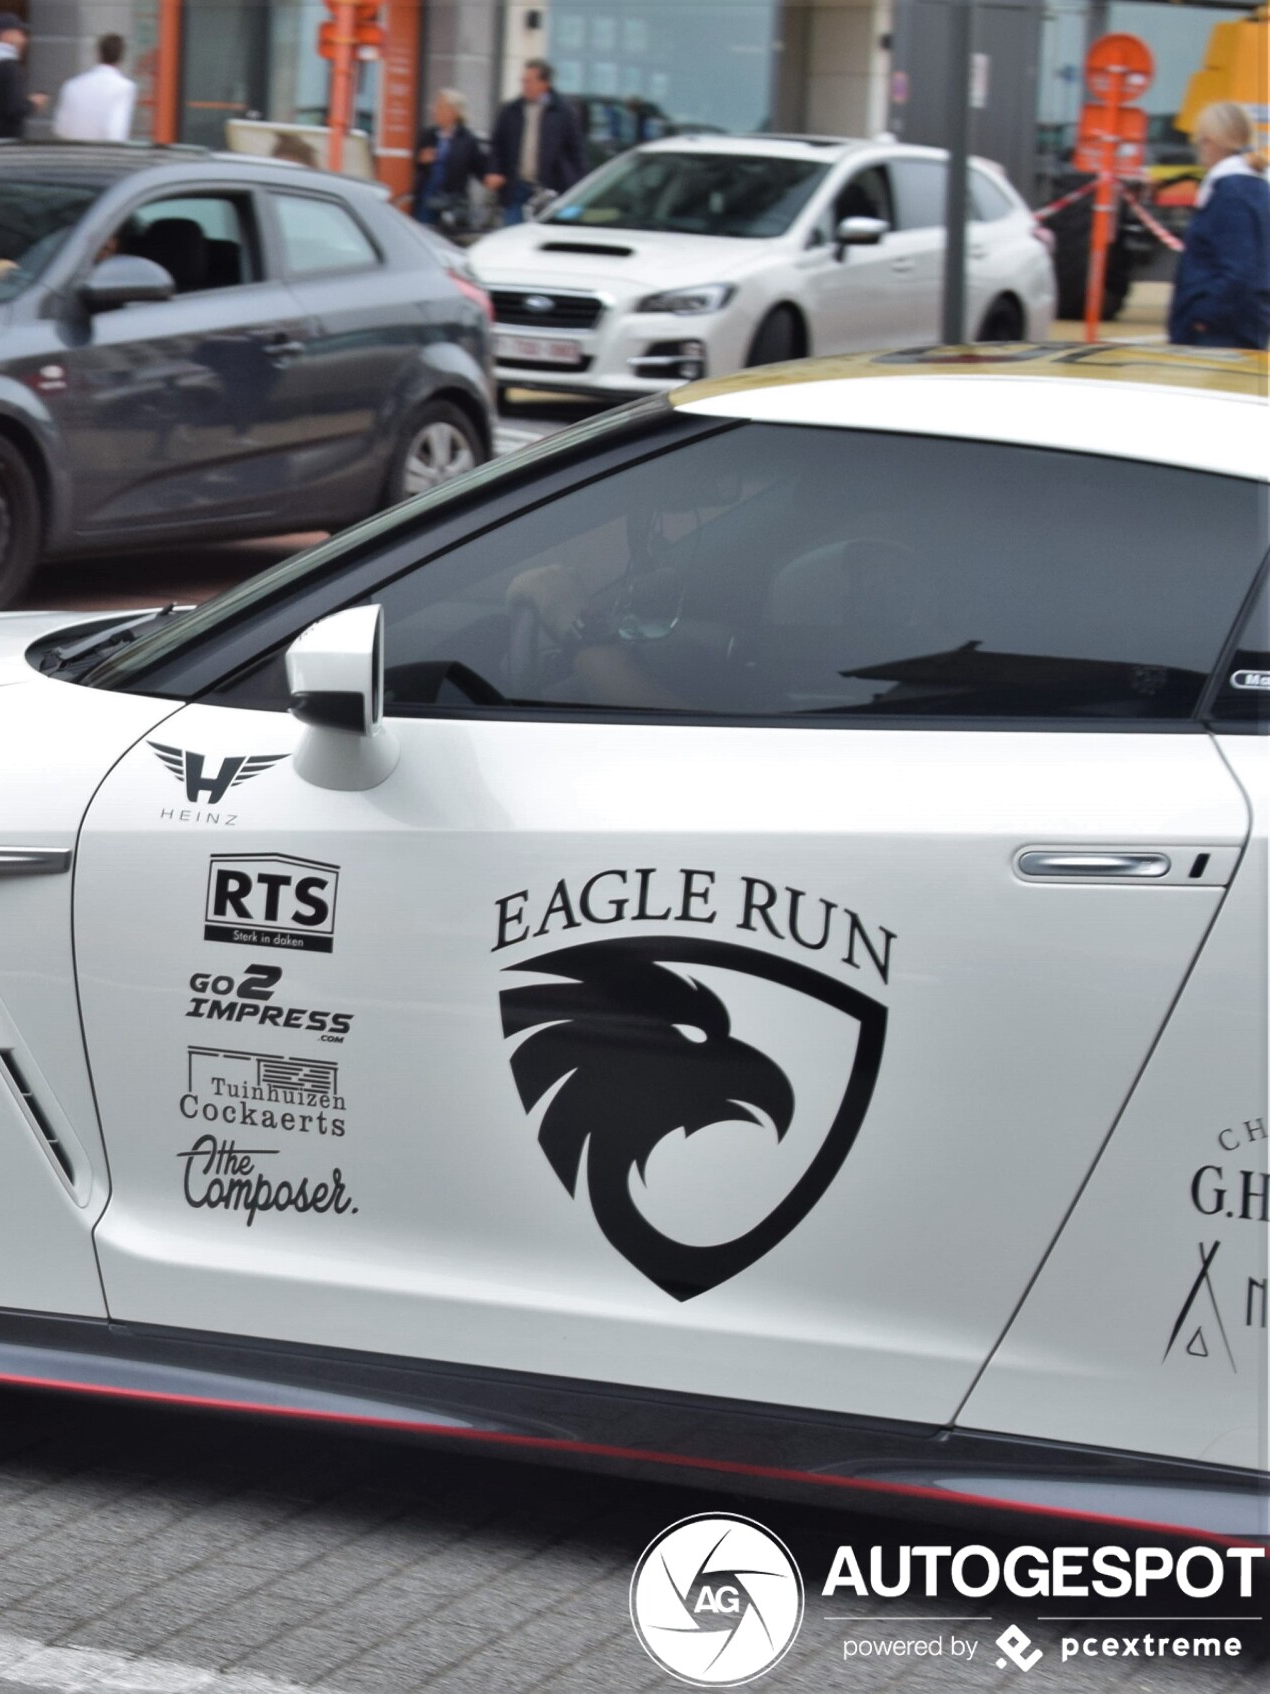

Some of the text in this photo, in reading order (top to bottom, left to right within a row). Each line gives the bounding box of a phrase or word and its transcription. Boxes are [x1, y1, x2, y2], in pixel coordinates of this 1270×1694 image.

[160, 808, 238, 825] HEINZ
[213, 869, 329, 926] RTS
[233, 929, 304, 947] Sterk in daken
[491, 868, 898, 986] EAGLE RUN
[185, 997, 355, 1034] IMPRESS
[211, 1077, 347, 1111] Tuinhuizen
[179, 1094, 346, 1137] Cockaerts
[1218, 1117, 1269, 1151] CH
